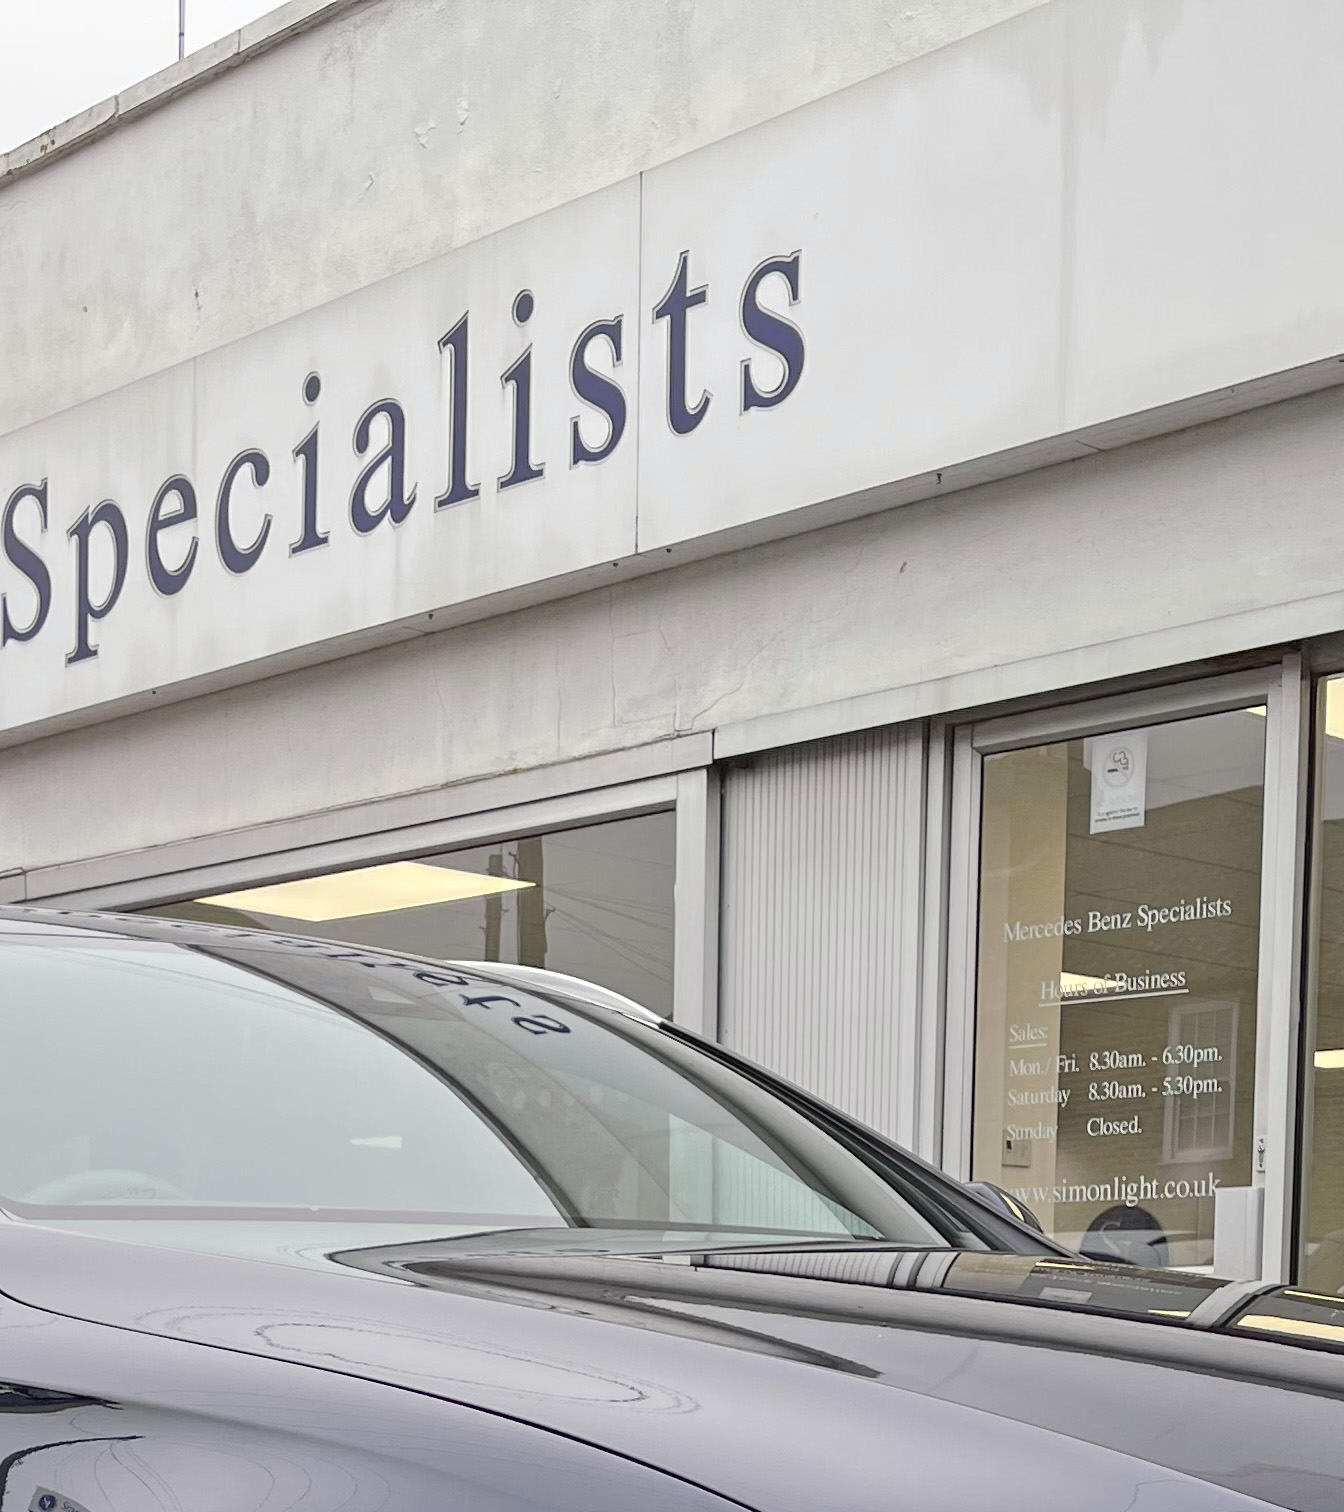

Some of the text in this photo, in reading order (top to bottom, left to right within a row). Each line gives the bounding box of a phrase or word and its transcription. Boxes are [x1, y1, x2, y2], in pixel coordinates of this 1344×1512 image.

[0, 247, 806, 667] Specialists
[1003, 896, 1232, 944] Mercedes Benz Specialists
[1040, 968, 1187, 1001] Hours of Business
[1009, 1024, 1048, 1042] Sales:
[1089, 1051, 1146, 1071] 8.30am.
[1162, 1045, 1223, 1068] 6.30pm.
[1007, 1087, 1071, 1108] Saturday
[1088, 1081, 1146, 1102] 8.30am.
[1162, 1075, 1223, 1099] 5.30pm.
[1006, 1115, 1143, 1144] Sunday Closed.
[1008, 1172, 1221, 1207] ww.simonlight.co.uk
